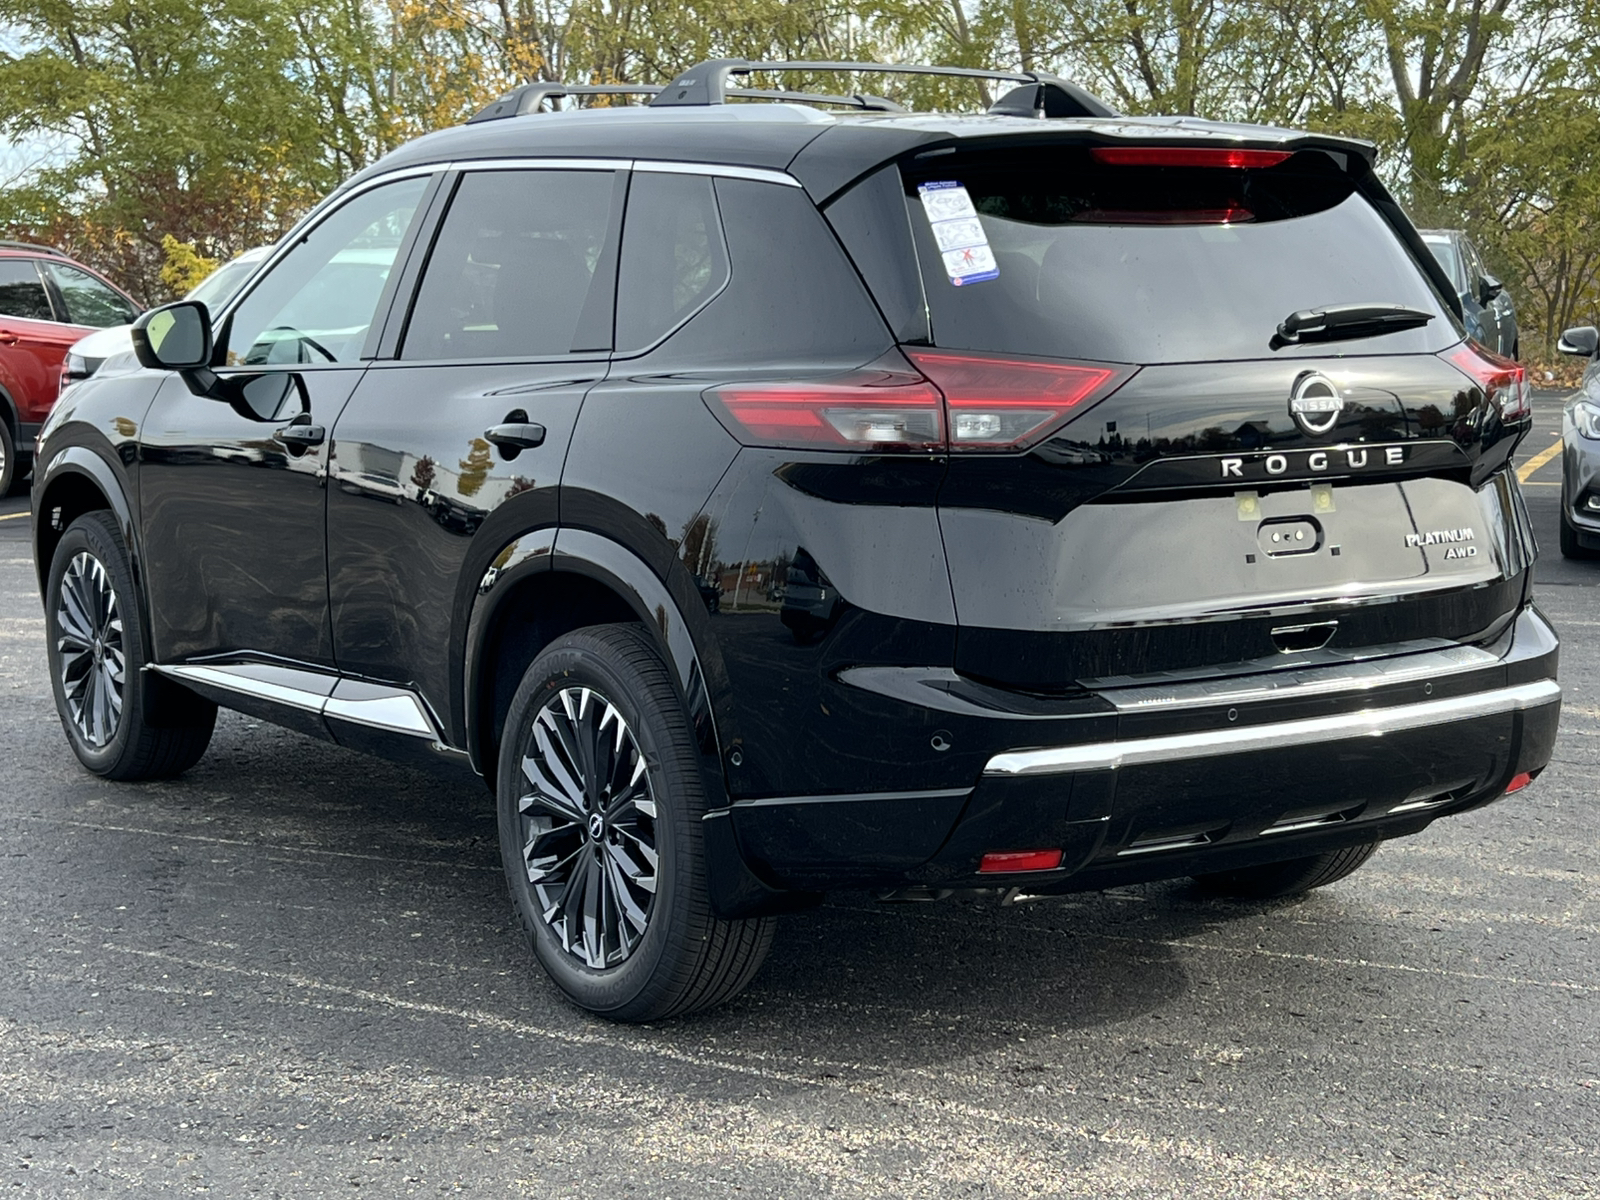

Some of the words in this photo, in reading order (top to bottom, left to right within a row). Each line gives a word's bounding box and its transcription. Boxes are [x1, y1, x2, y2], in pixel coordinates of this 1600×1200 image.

[1292, 399, 1343, 412] NISSAN
[1221, 447, 1404, 477] ROGUE
[1404, 527, 1475, 547] PLATINUM
[1445, 545, 1477, 559] AWD
